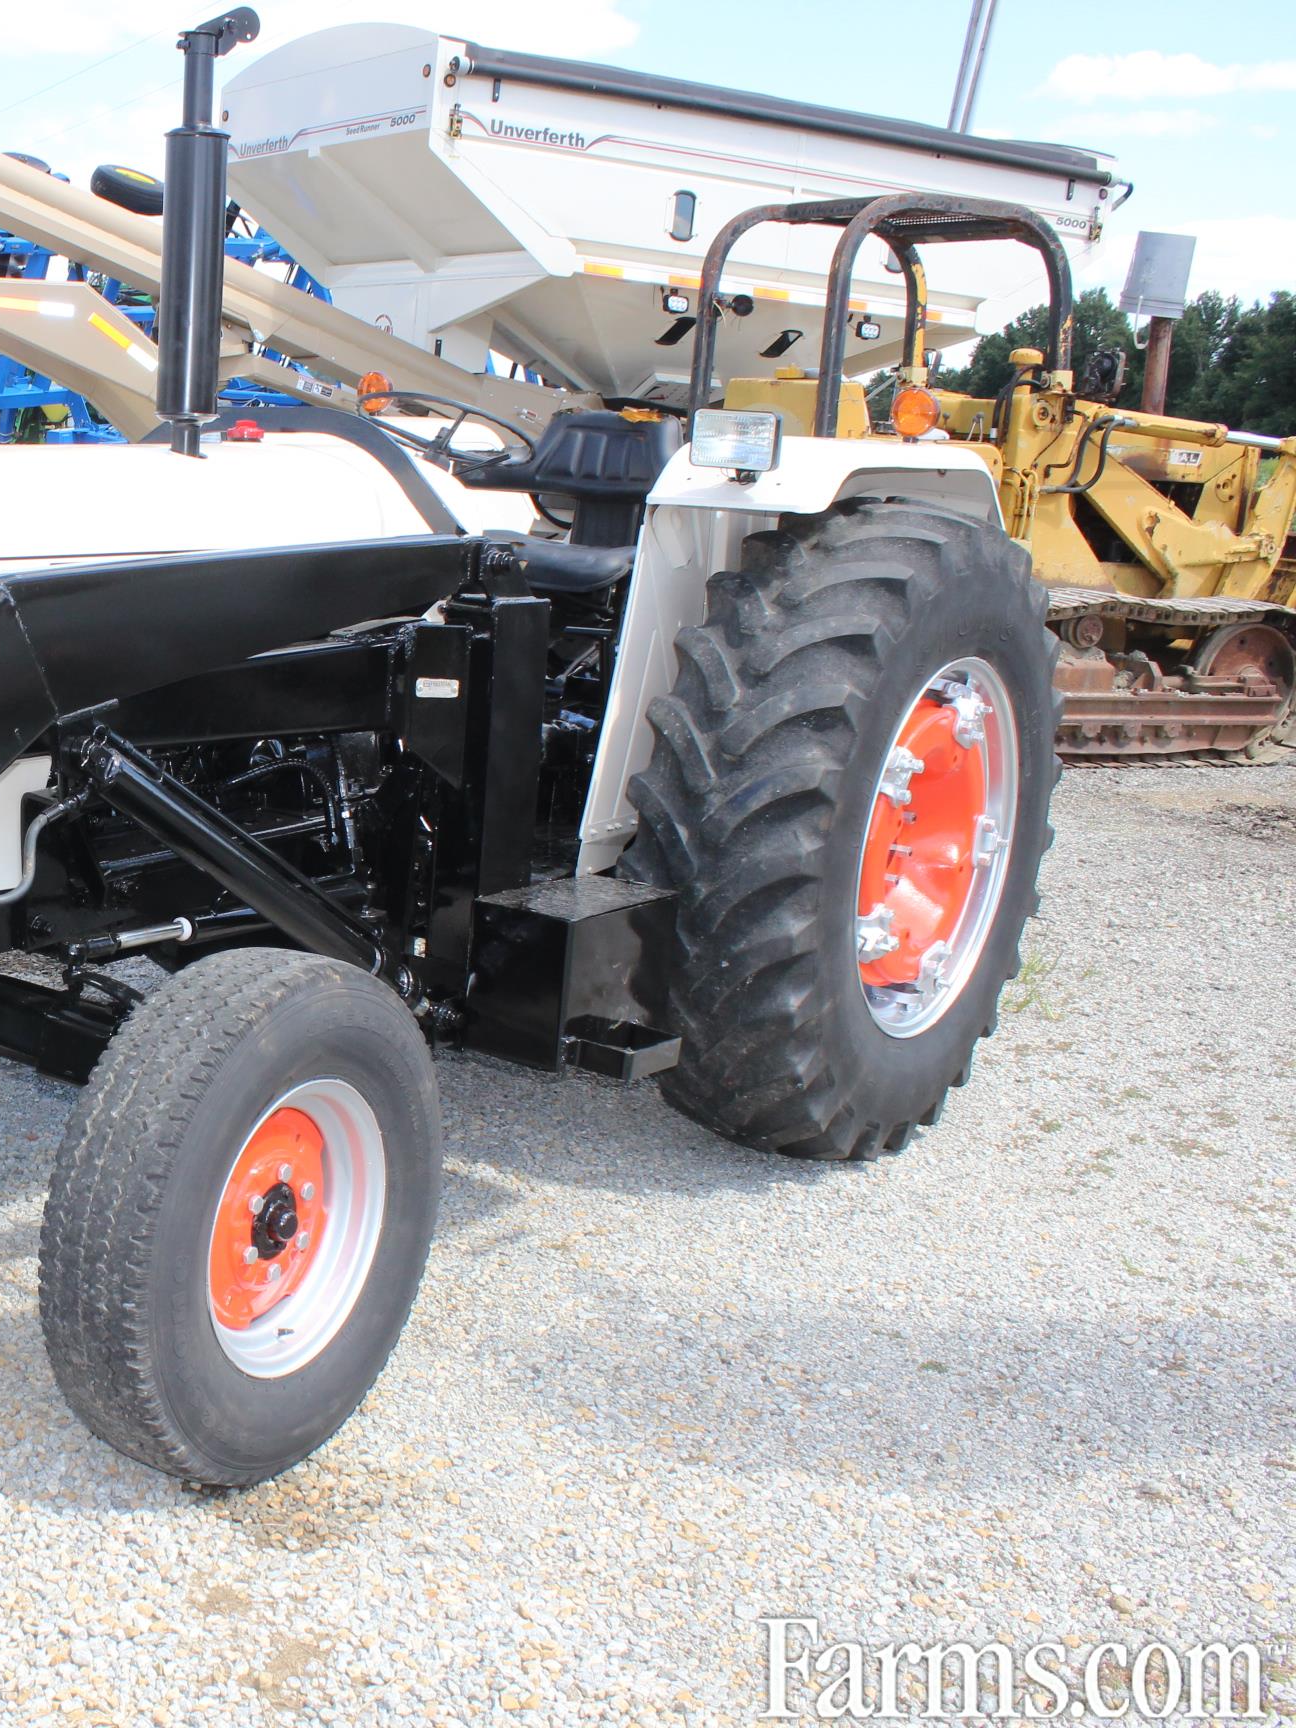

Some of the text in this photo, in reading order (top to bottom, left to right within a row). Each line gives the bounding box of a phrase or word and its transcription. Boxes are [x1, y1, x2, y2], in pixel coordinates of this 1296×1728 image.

[390, 113, 416, 127] 5000
[490, 119, 585, 148] Unverferth
[240, 135, 288, 156] Unverferth
[1056, 216, 1087, 229] 5000
